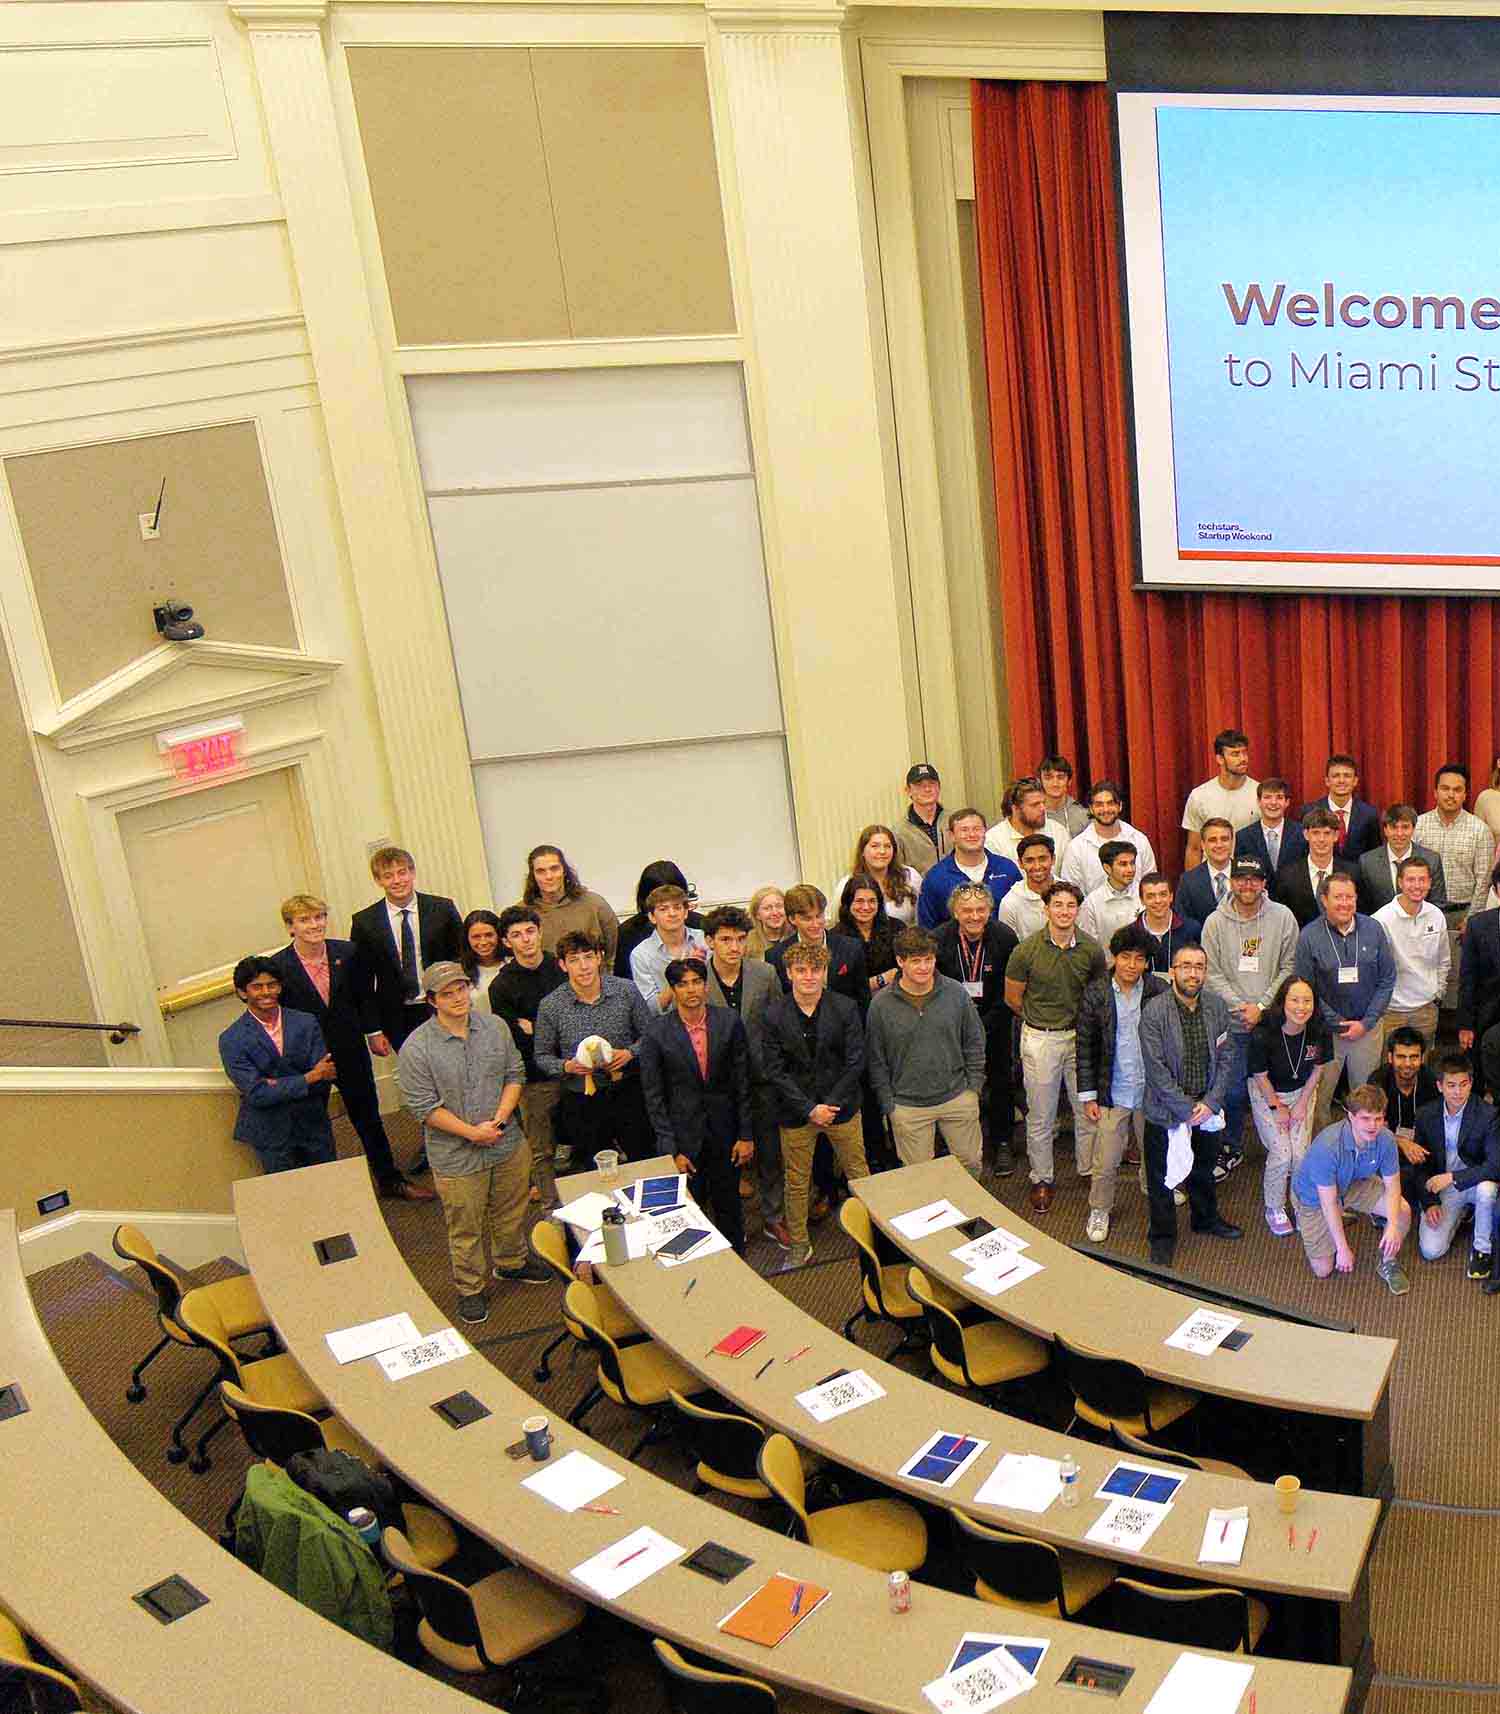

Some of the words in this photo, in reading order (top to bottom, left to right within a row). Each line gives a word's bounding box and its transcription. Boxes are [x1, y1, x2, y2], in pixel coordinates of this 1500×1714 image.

[1224, 353, 1272, 388] to
[1290, 351, 1440, 393] Miami
[1198, 531, 1231, 542] Startup
[1231, 532, 1273, 542] Weekend
